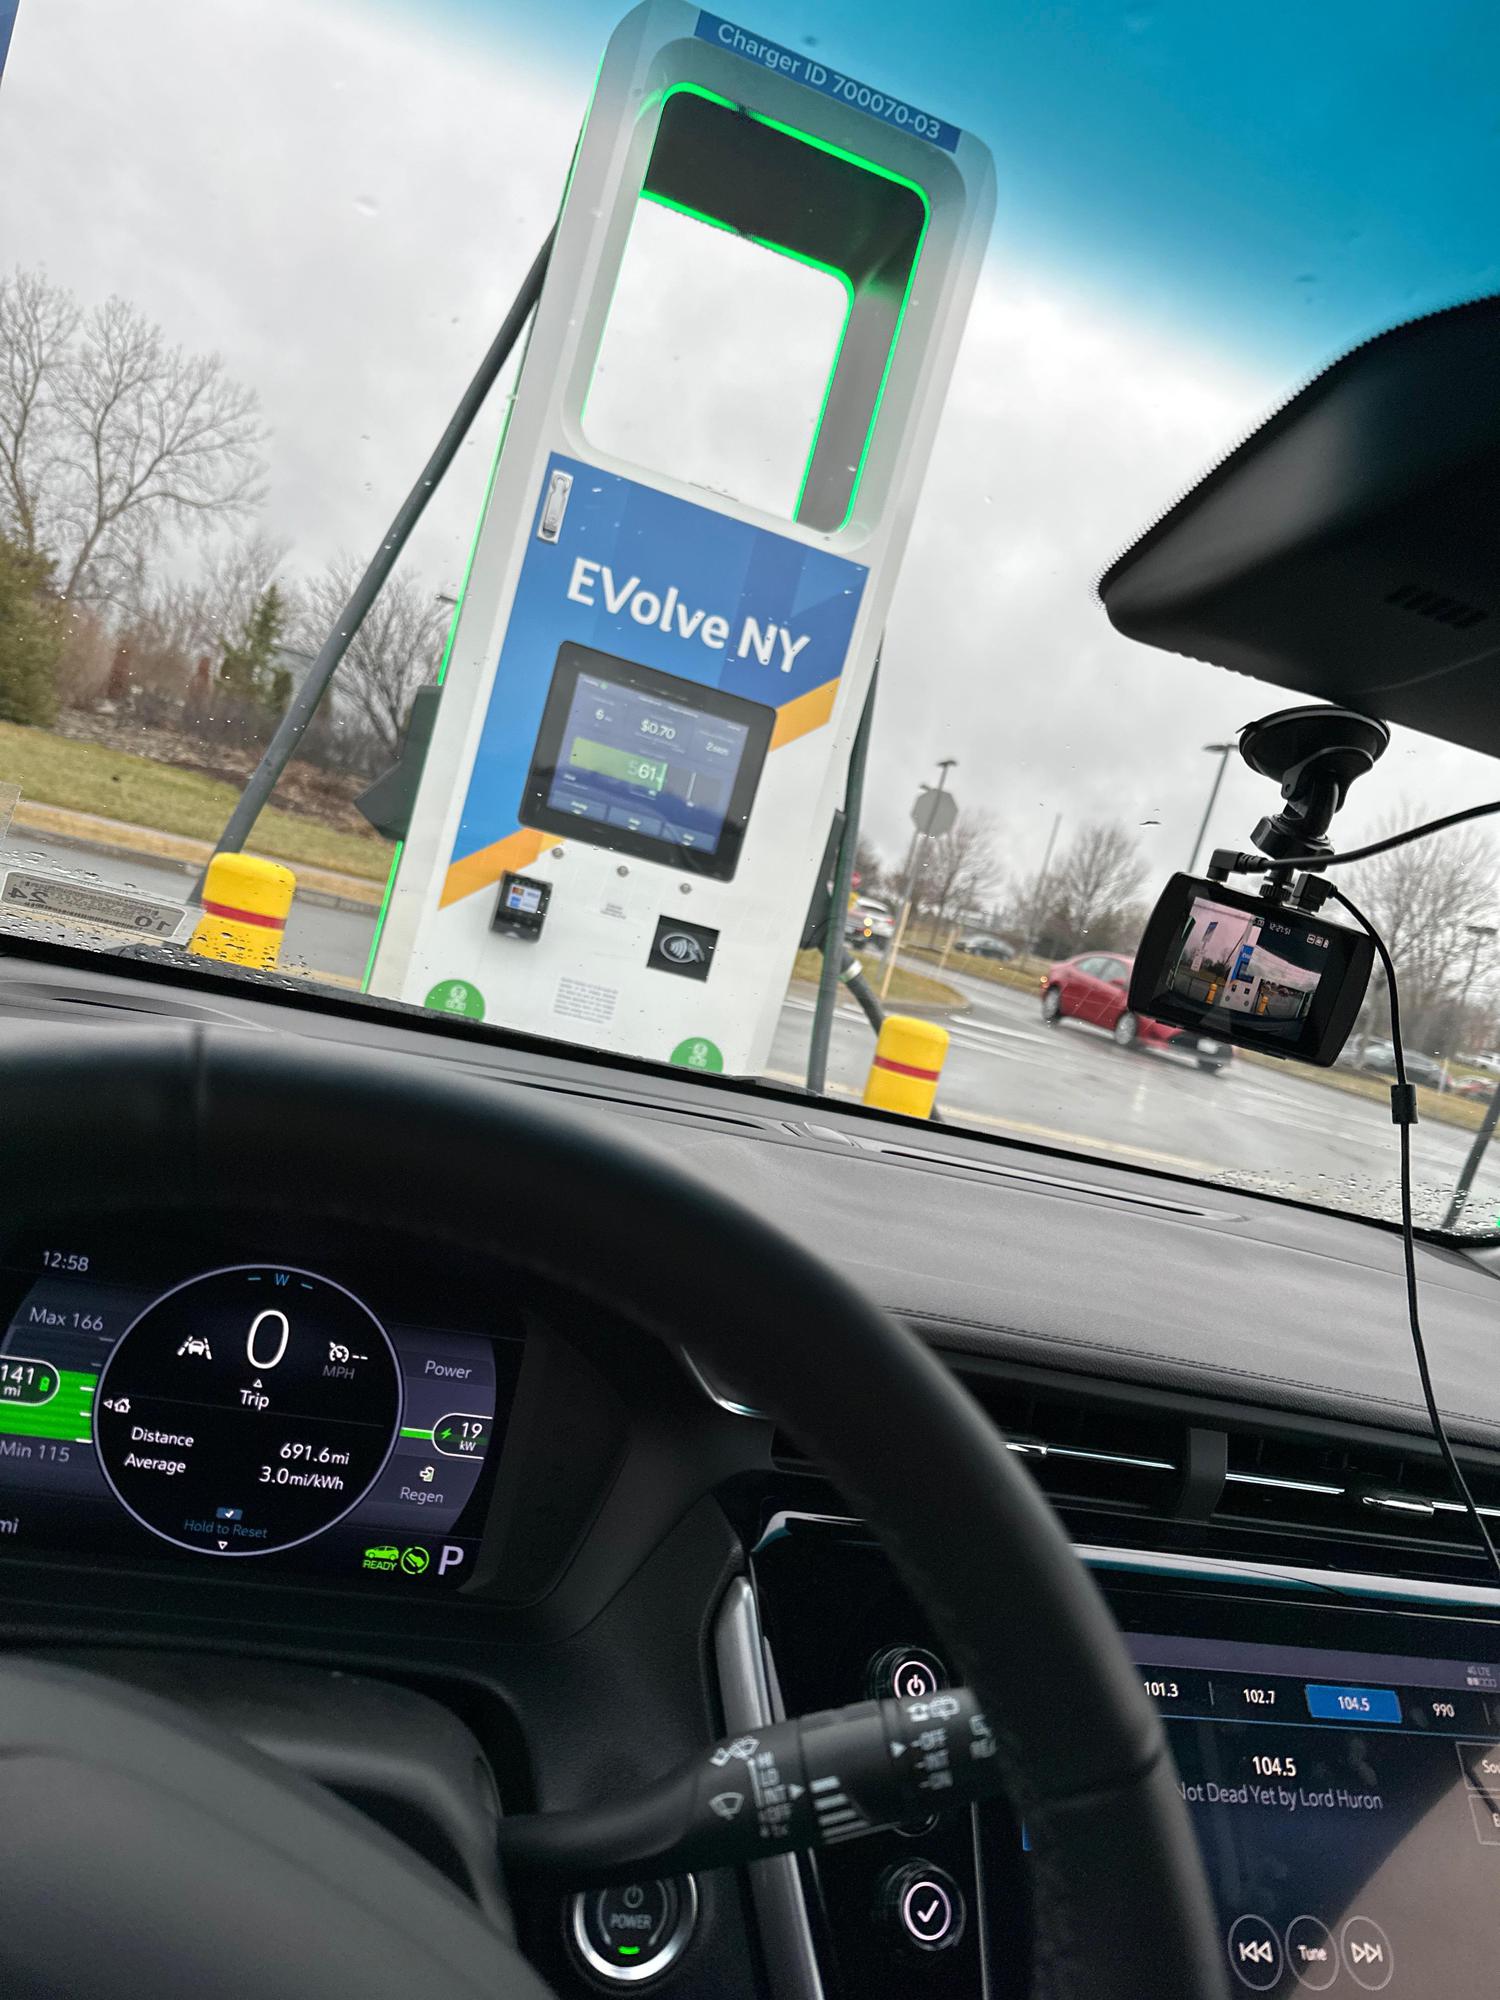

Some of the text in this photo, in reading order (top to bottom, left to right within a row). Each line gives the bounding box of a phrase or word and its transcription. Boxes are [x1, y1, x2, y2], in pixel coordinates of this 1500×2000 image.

[717, 23, 941, 140] Charger ID 700070-03
[567, 556, 811, 673] EVolve NY
[639, 718, 677, 741] $0.70
[42, 1251, 89, 1272] 12:58
[274, 1274, 290, 1287] W
[29, 1306, 104, 1332] Max 166
[246, 1309, 290, 1370] 0
[0, 1364, 35, 1385] 141
[323, 1364, 356, 1381] MPH
[424, 1360, 473, 1380] Power
[3, 1385, 21, 1397] mi
[240, 1389, 270, 1410] Trip
[131, 1426, 195, 1448] Distance
[461, 1422, 483, 1439] 19
[0, 1440, 70, 1463] Min 115
[459, 1440, 477, 1452] kW
[124, 1453, 187, 1476] Average
[400, 1486, 444, 1504] Regen
[183, 1519, 268, 1539] Hold to Reset
[362, 1560, 398, 1572] READY
[437, 1545, 465, 1576] P
[1144, 1681, 1179, 1698] 101.3
[1243, 1688, 1276, 1705] 102.7
[1337, 1696, 1370, 1712] 104.5
[1432, 1702, 1455, 1718] 990
[1252, 1756, 1297, 1777] 104.5
[1206, 1782, 1248, 1804] Dead
[1249, 1784, 1276, 1805] Yet
[1278, 1787, 1297, 1810] by
[1300, 1789, 1334, 1809] Lord
[1338, 1790, 1383, 1810] Huron
[610, 1914, 652, 1930] POWER
[1298, 1944, 1327, 1961] Tune
